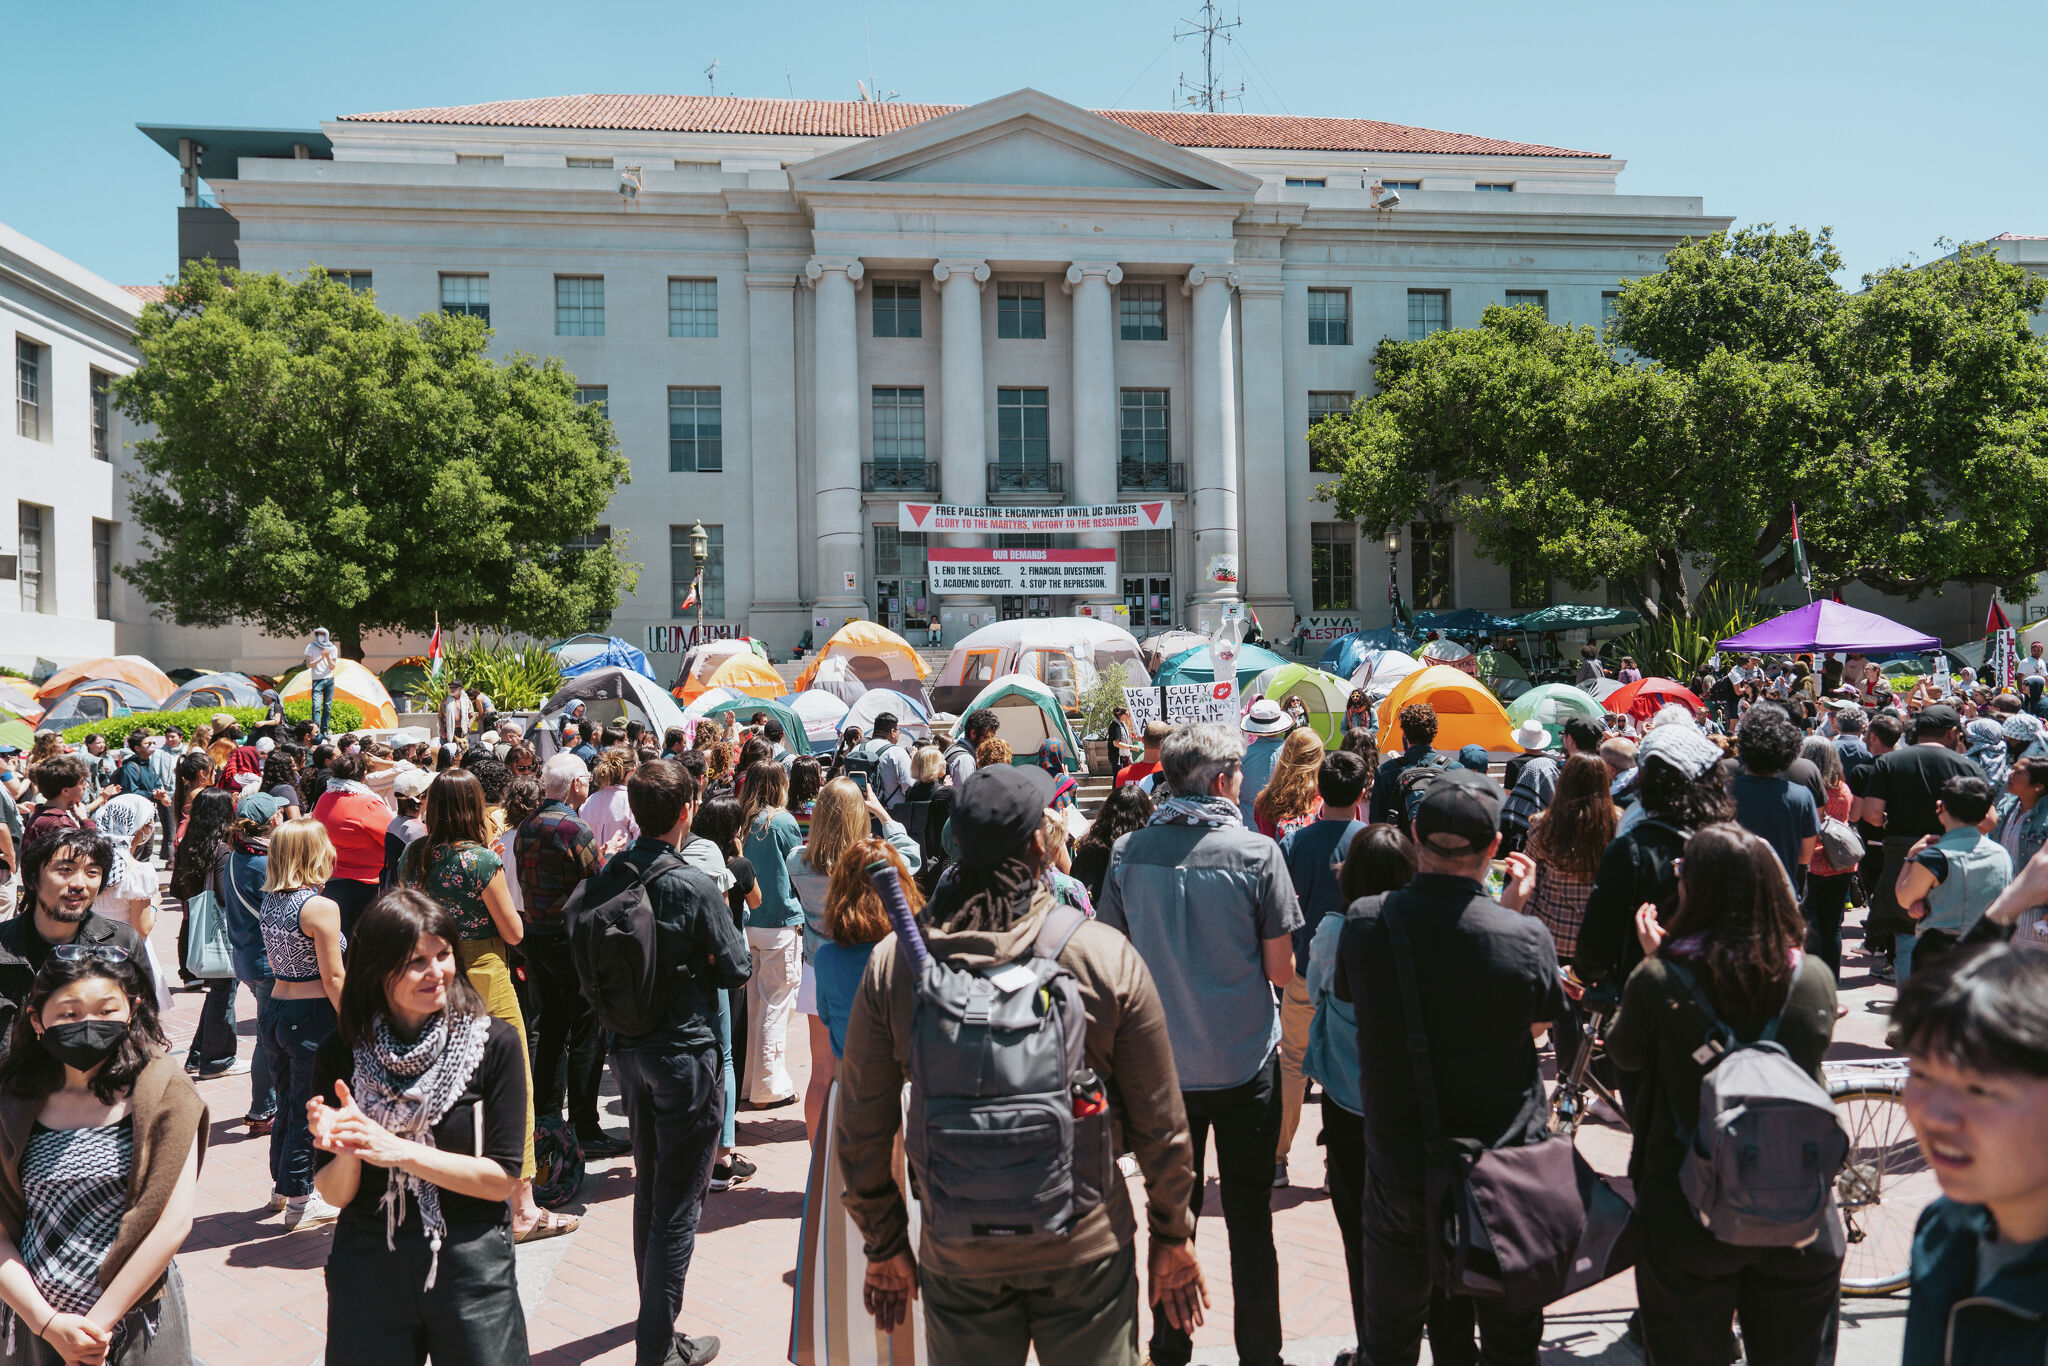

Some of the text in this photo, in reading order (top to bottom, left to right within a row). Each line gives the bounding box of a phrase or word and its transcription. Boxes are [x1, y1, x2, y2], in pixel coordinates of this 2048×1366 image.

[936, 505, 1137, 518] FREE PALESTINE ENCAMPMENT UNTIL UC DIVESTS
[935, 516, 1139, 530] GLORY TO THE MARTYRS, VICTORY TO THE RESISTANCE!
[993, 550, 1047, 560] OUR DEMANDS
[934, 566, 1002, 575] 1. END THE SILENCE.
[1020, 566, 1106, 575] 2. FINANCIAL DIVESTMENT.
[934, 580, 1013, 588] 3. ACADEMIC BOYCOTT.
[1020, 580, 1107, 588] 4. STOP THE REPRESSION.
[1309, 618, 1352, 627] VIVA
[1302, 627, 1359, 640] ALESTIN
[1127, 684, 1208, 697] UC FCULTY
[1130, 694, 1197, 707] AND TAFF
[1155, 706, 1200, 716] JSTICE
[1206, 704, 1218, 714] IN
